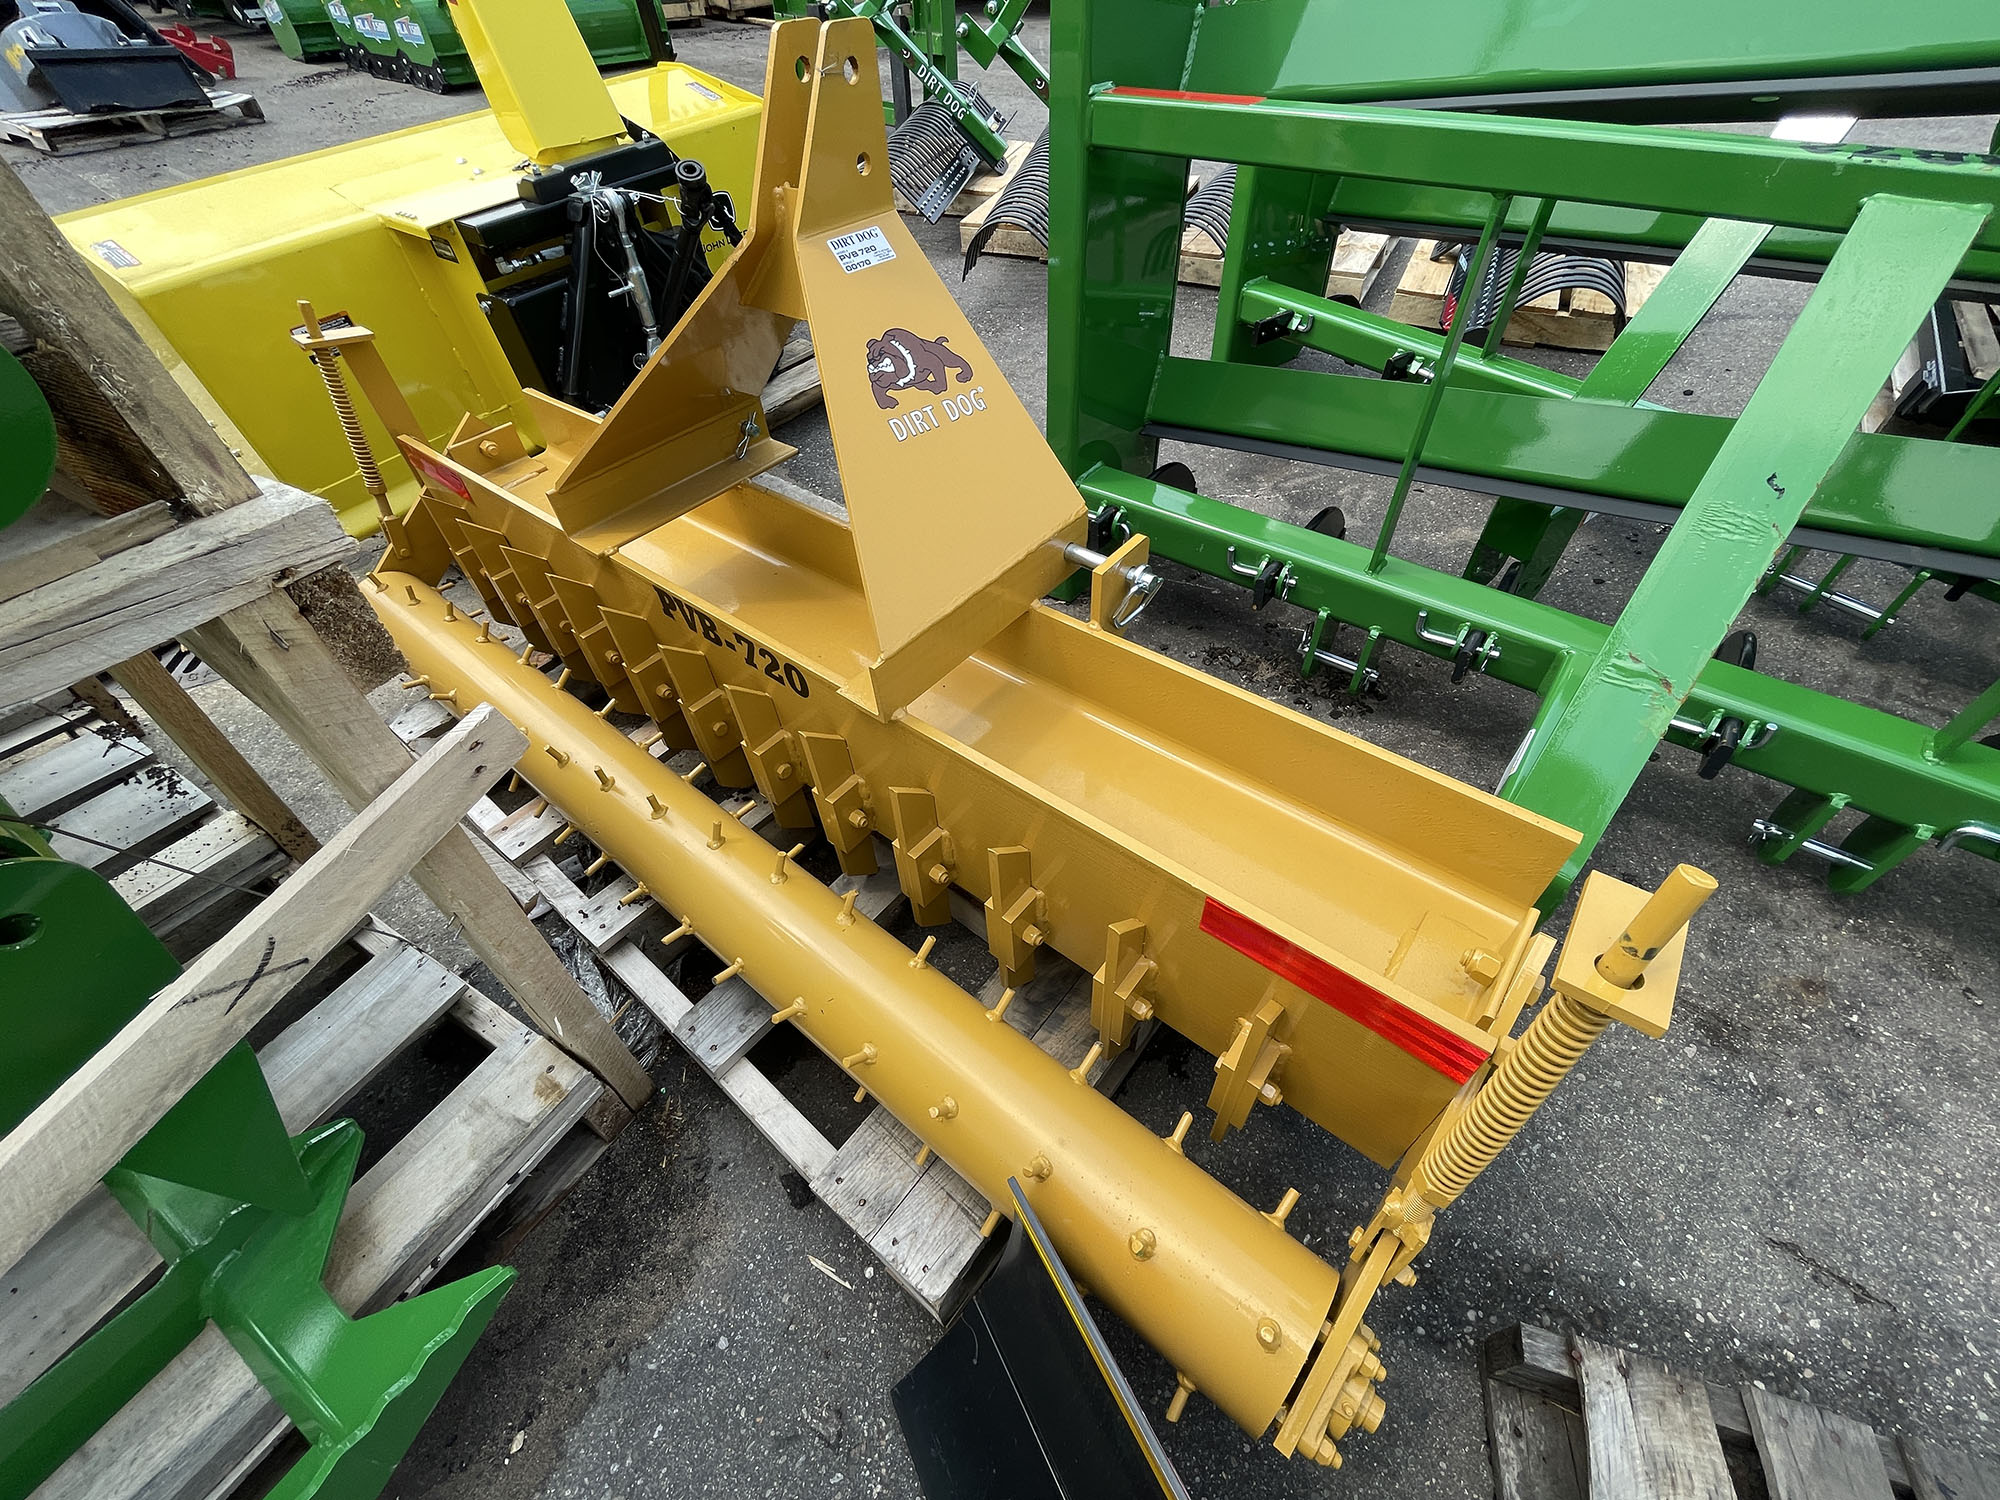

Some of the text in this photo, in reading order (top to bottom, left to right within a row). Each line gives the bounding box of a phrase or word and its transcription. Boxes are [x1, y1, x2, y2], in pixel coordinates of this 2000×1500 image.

[916, 64, 967, 121] DIRT DOG
[830, 228, 879, 250] DIRT DOG
[838, 250, 859, 261] PVB
[858, 245, 877, 255] 720
[845, 259, 872, 272] 00170
[887, 387, 987, 442] DIRT DOG
[652, 584, 810, 699] PVB-720
